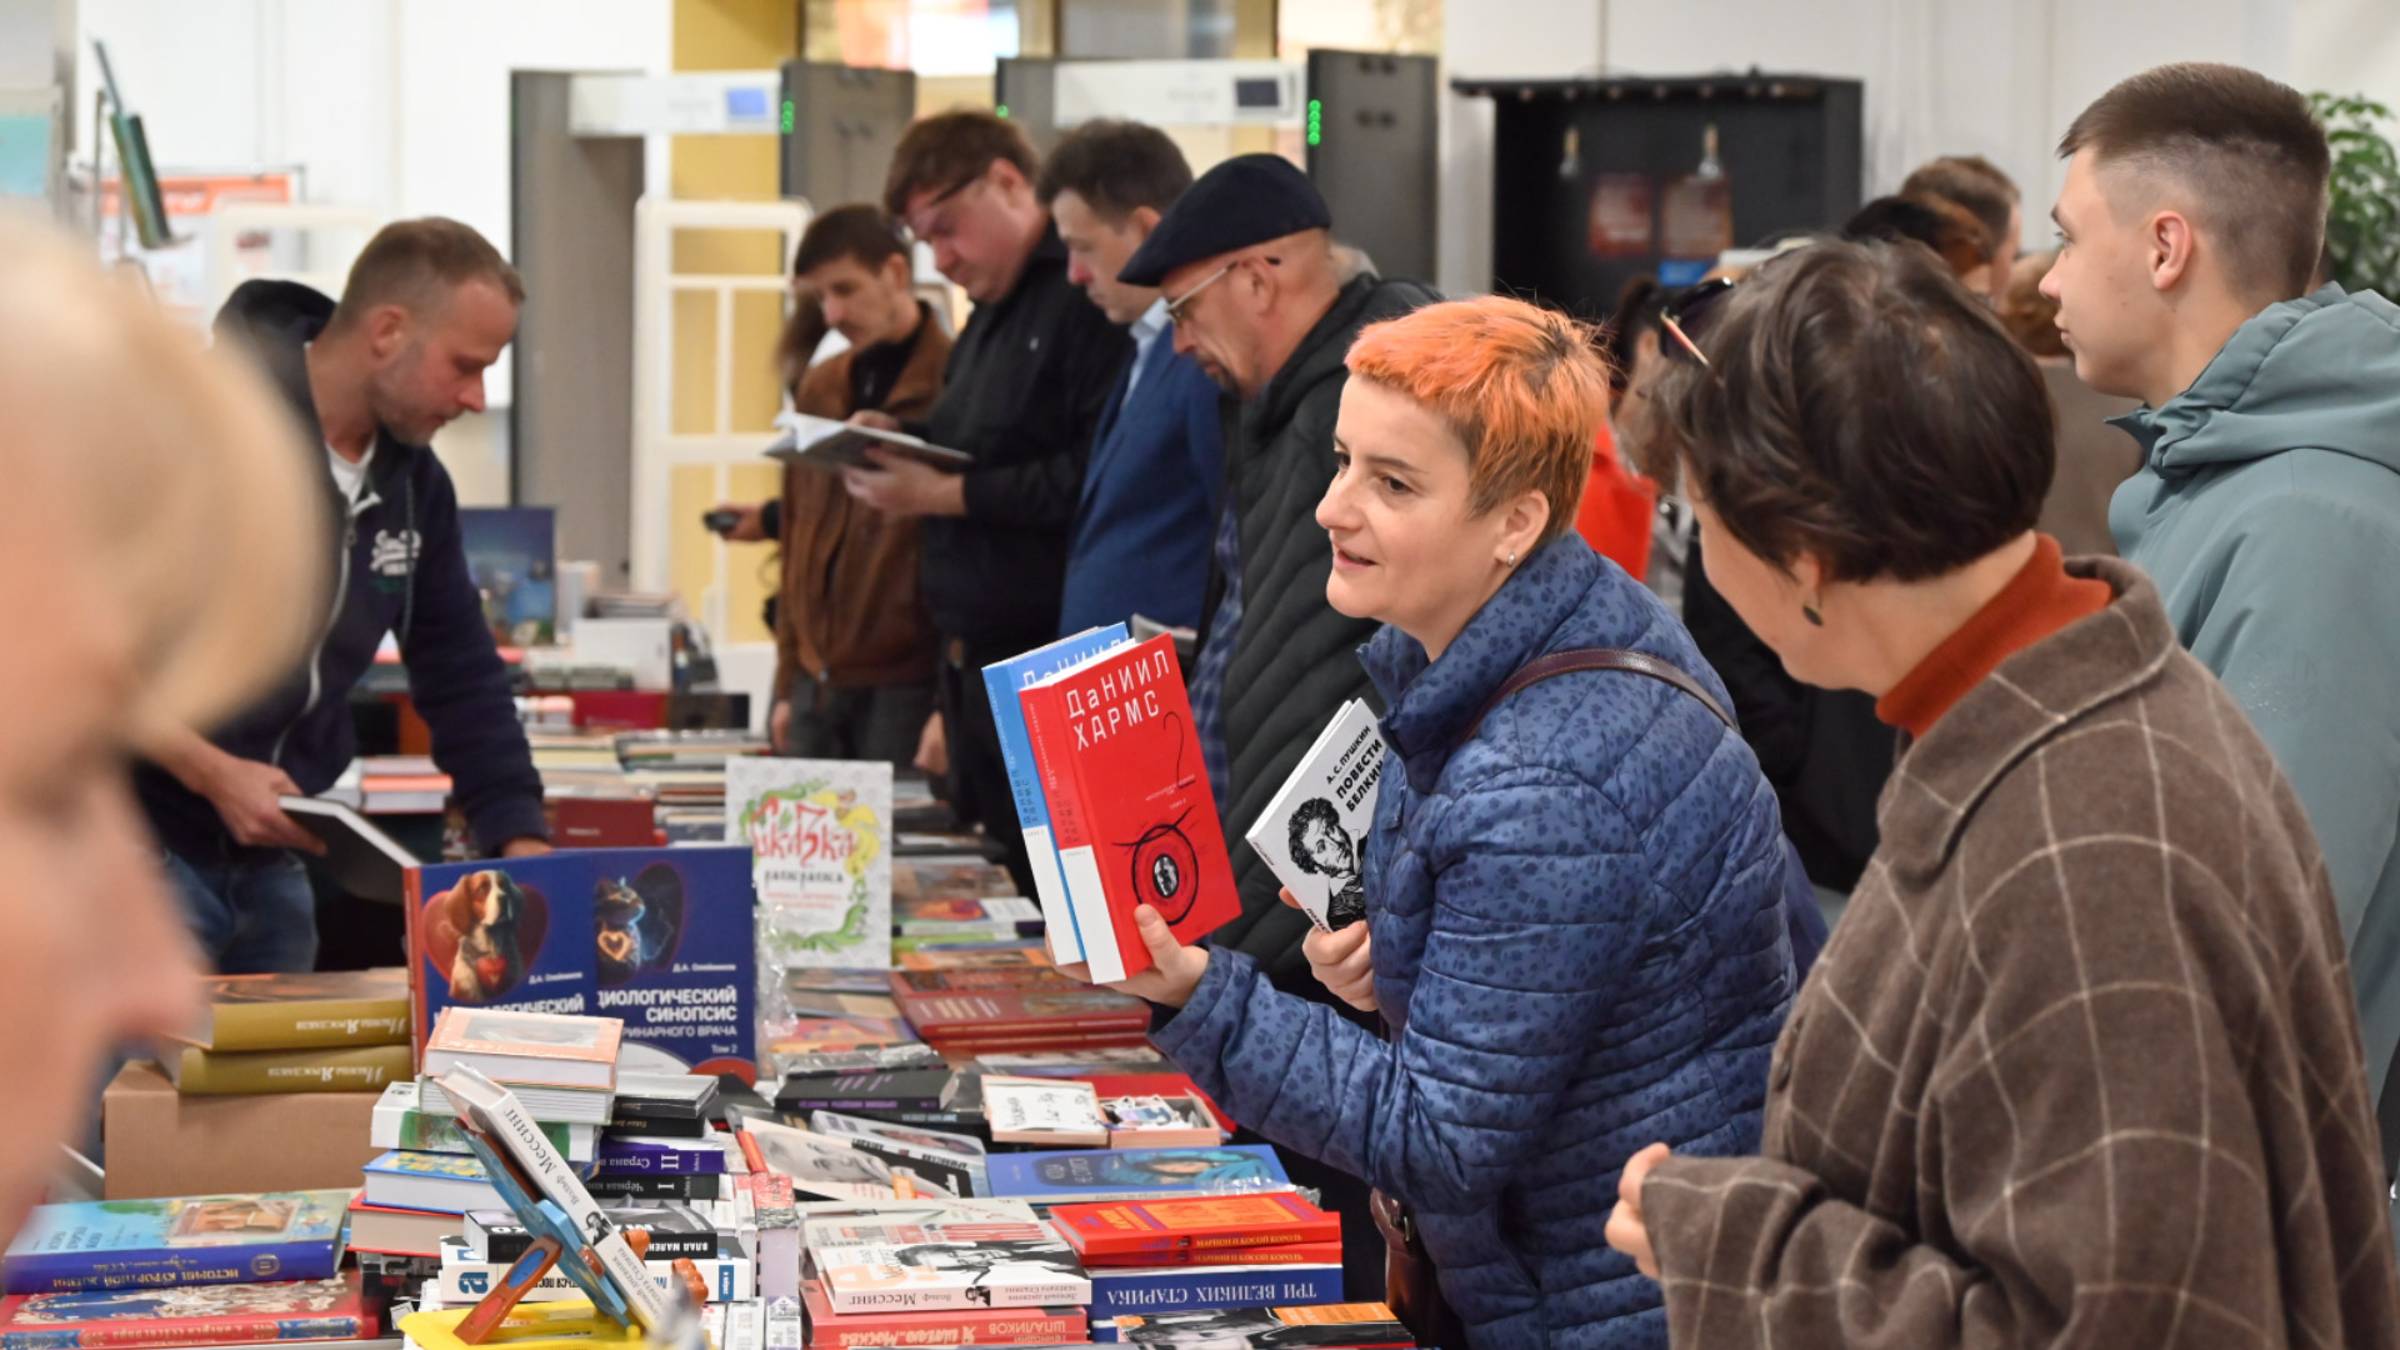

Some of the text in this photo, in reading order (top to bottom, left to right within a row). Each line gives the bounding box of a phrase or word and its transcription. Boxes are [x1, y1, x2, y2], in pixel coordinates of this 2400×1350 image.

[1074, 690, 1159, 751] ХАРМС
[1326, 775, 1336, 784] А.
[1340, 726, 1371, 766] ПУШКИН
[1336, 739, 1382, 799] ПОВЕСТИ
[1346, 760, 1383, 812] БЕЛКИН
[646, 1006, 737, 1023] СИНОПСИС
[623, 1024, 737, 1038] РИНАРНОГО ВРАЧА
[730, 1044, 738, 1054] 2
[503, 1109, 558, 1174] Мессинг
[649, 1242, 708, 1251] ВЛАД МАЛЕН
[535, 1277, 580, 1288] ТЬСЯ ПОС
[850, 1292, 916, 1306] Мессинг
[1107, 1282, 1317, 1305] ТРИ ВЕЛИКИХ СТАРИКА
[988, 1320, 1066, 1335] ШПАЛИКОВ
